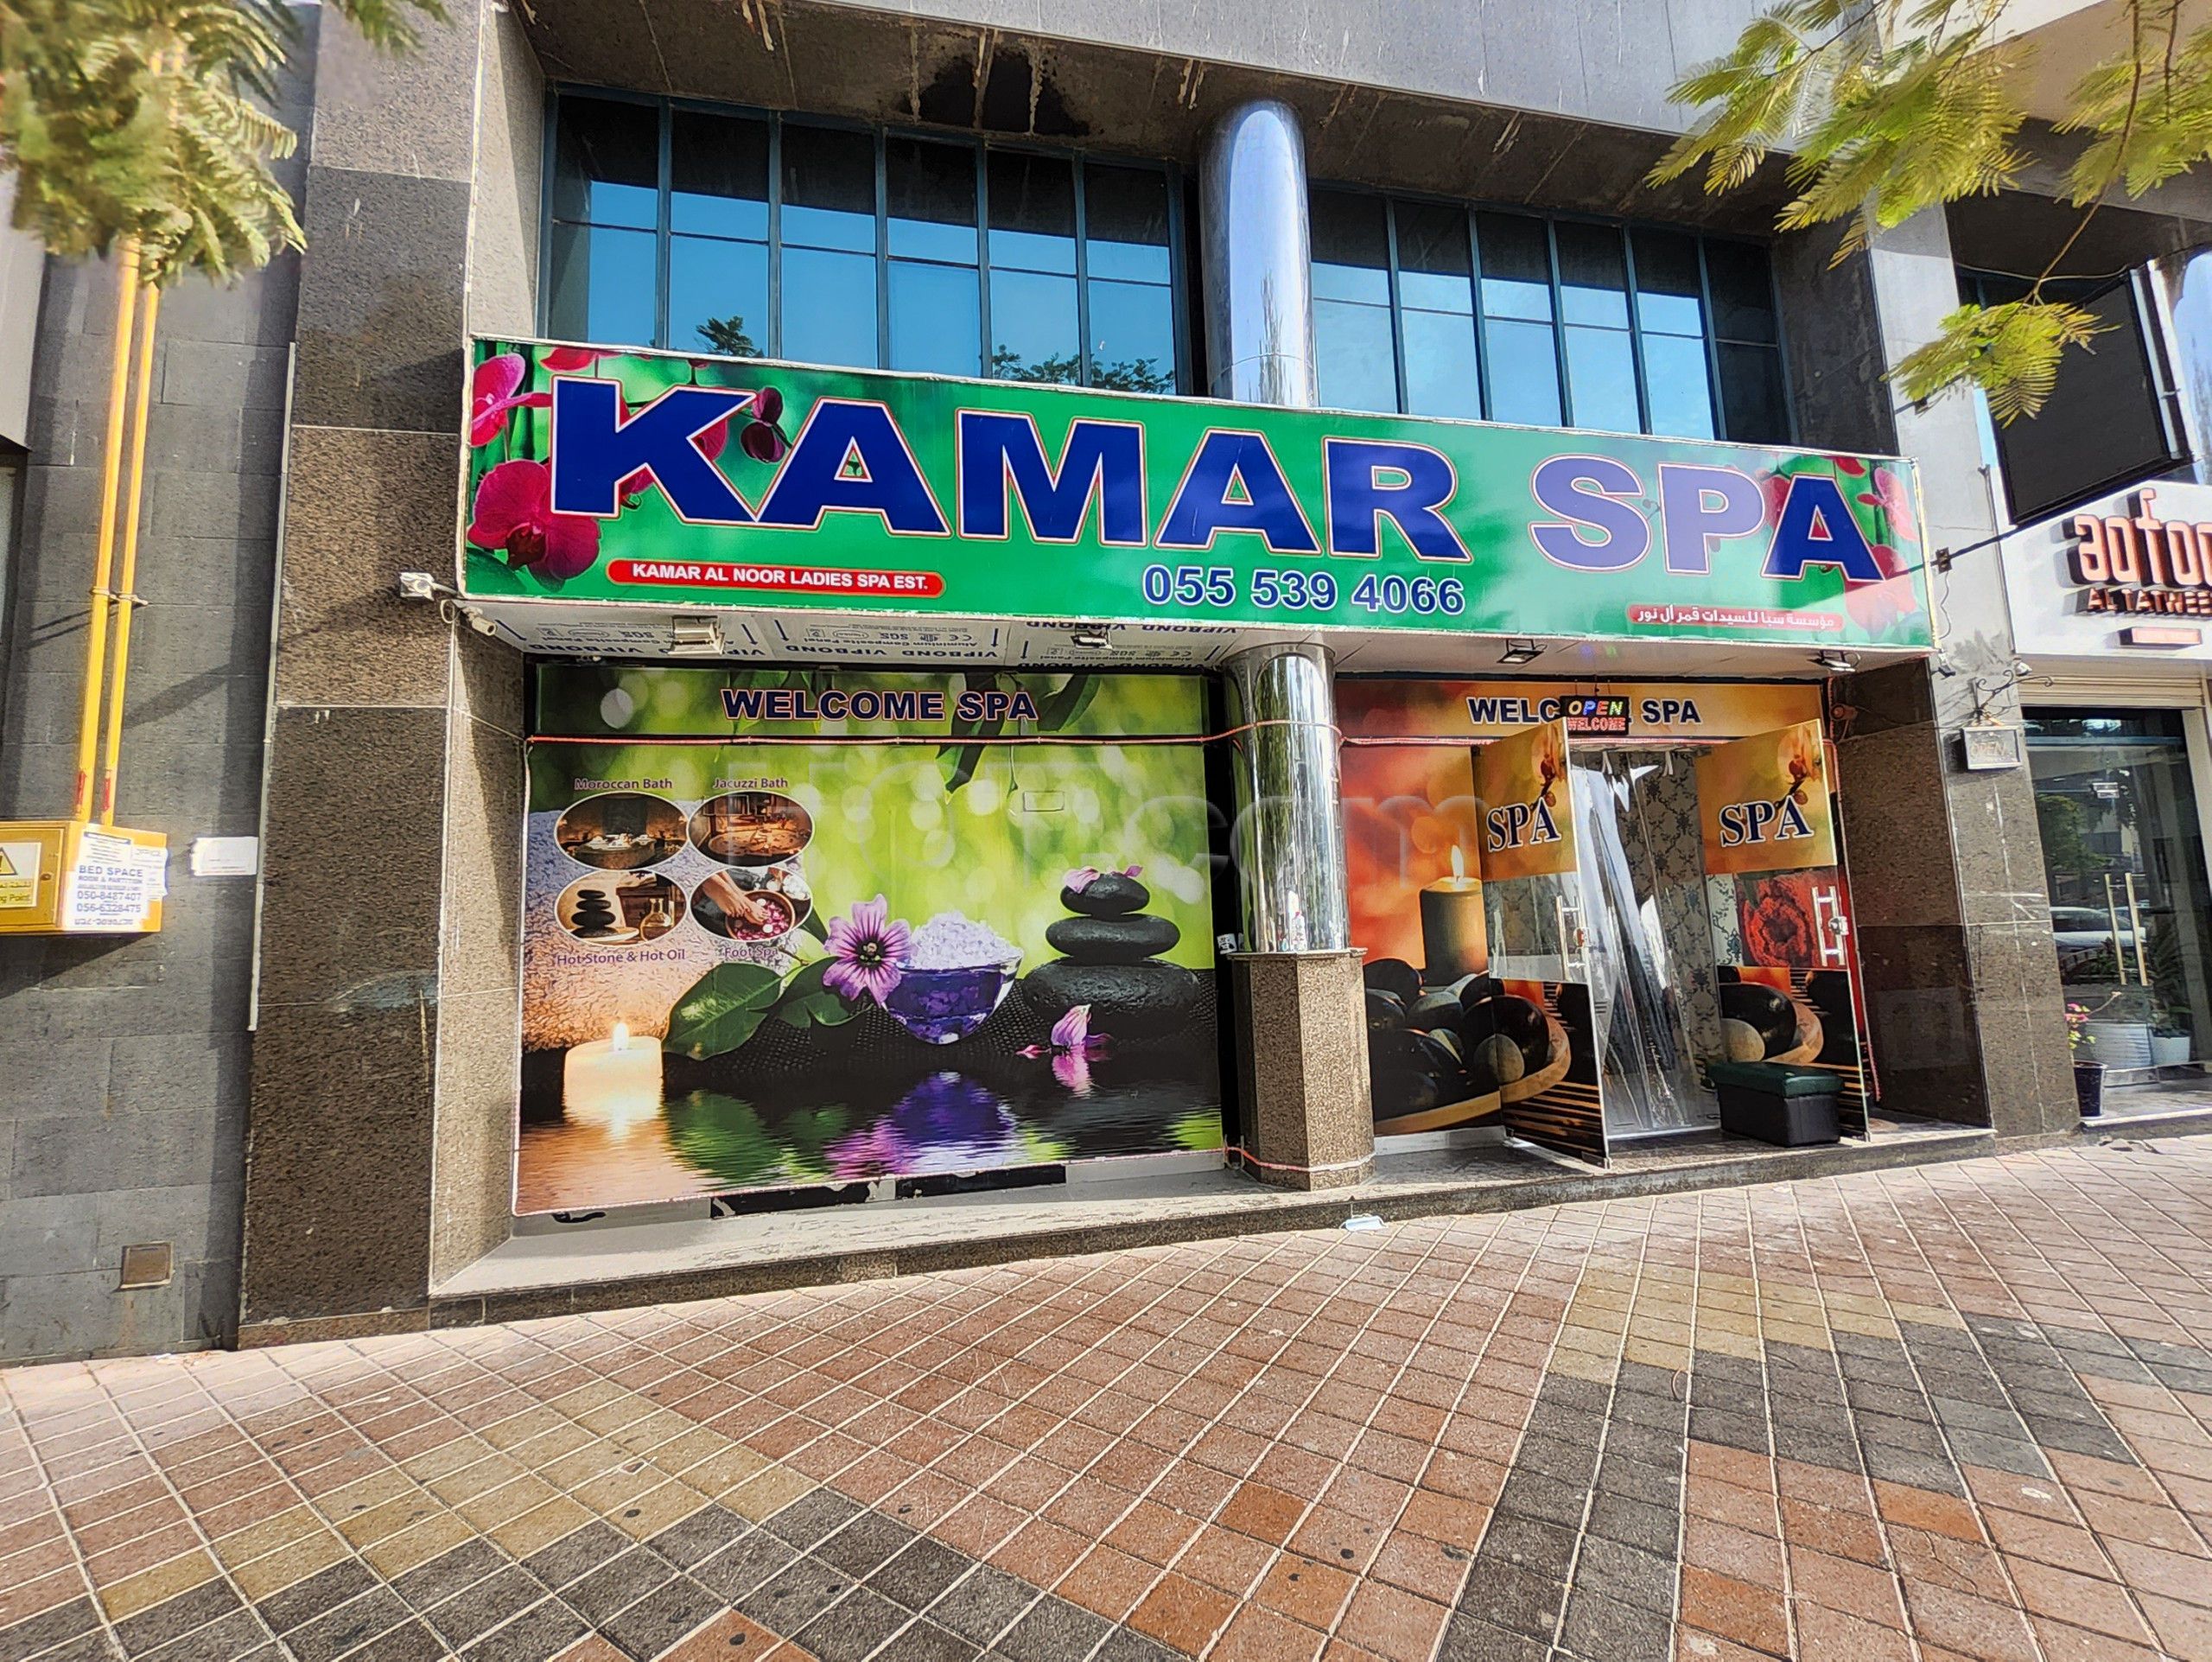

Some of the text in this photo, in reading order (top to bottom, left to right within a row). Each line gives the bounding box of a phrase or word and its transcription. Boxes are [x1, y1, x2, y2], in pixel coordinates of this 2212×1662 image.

[550, 374, 1885, 583] KAMAR SPA
[632, 563, 928, 589] KAMAR AL NOOR LADIES SPA EST.
[1142, 564, 1465, 615] 055 539 4066
[2121, 589, 2212, 614] TATWEE
[1637, 608, 1657, 622] نور
[1675, 607, 1699, 622] قمر
[1141, 624, 1237, 634] VIPBOND
[785, 645, 999, 659] VIPBOND VIPBOND
[721, 689, 1039, 721] WELCOME SPA
[1466, 697, 1702, 724] WELC SPA
[1568, 700, 1624, 716] OPEN
[1567, 717, 1625, 731] WELCOME
[574, 778, 672, 790] Moroccan Bath
[714, 778, 788, 790] Jacuzzi Bath
[1486, 797, 1561, 851] SPA
[1719, 795, 1815, 847] SPA
[79, 865, 143, 877] BED SPACE
[556, 949, 685, 965] Hot Stone & Hot Oil
[724, 947, 752, 958] Foot
